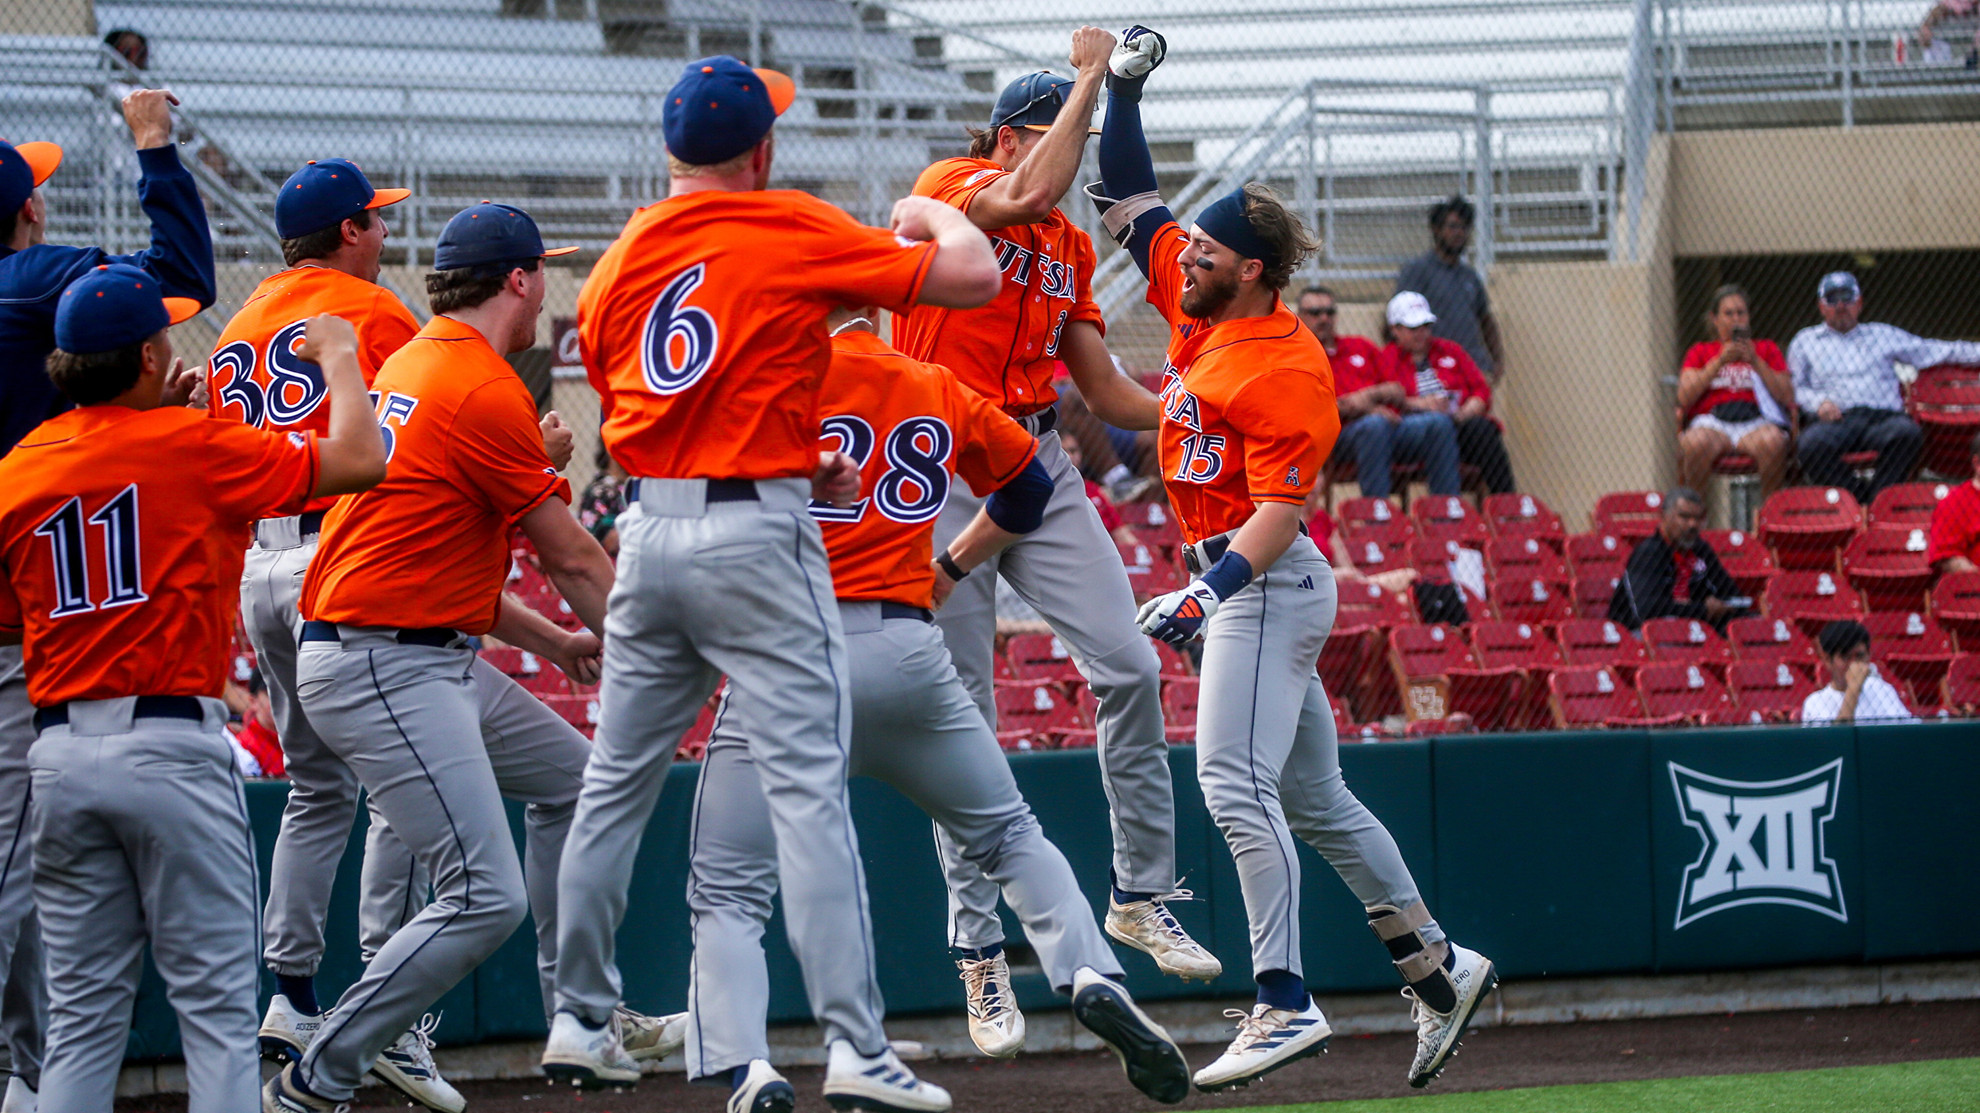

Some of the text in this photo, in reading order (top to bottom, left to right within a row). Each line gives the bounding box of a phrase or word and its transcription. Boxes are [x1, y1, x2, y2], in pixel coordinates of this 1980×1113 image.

[211, 318, 330, 430] 38
[640, 261, 719, 396] 6
[1046, 310, 1067, 356] 3
[368, 391, 420, 464] 5
[807, 415, 953, 524] 28
[1173, 433, 1226, 484] 15
[33, 482, 149, 619] 11
[1685, 780, 1833, 906] XII
